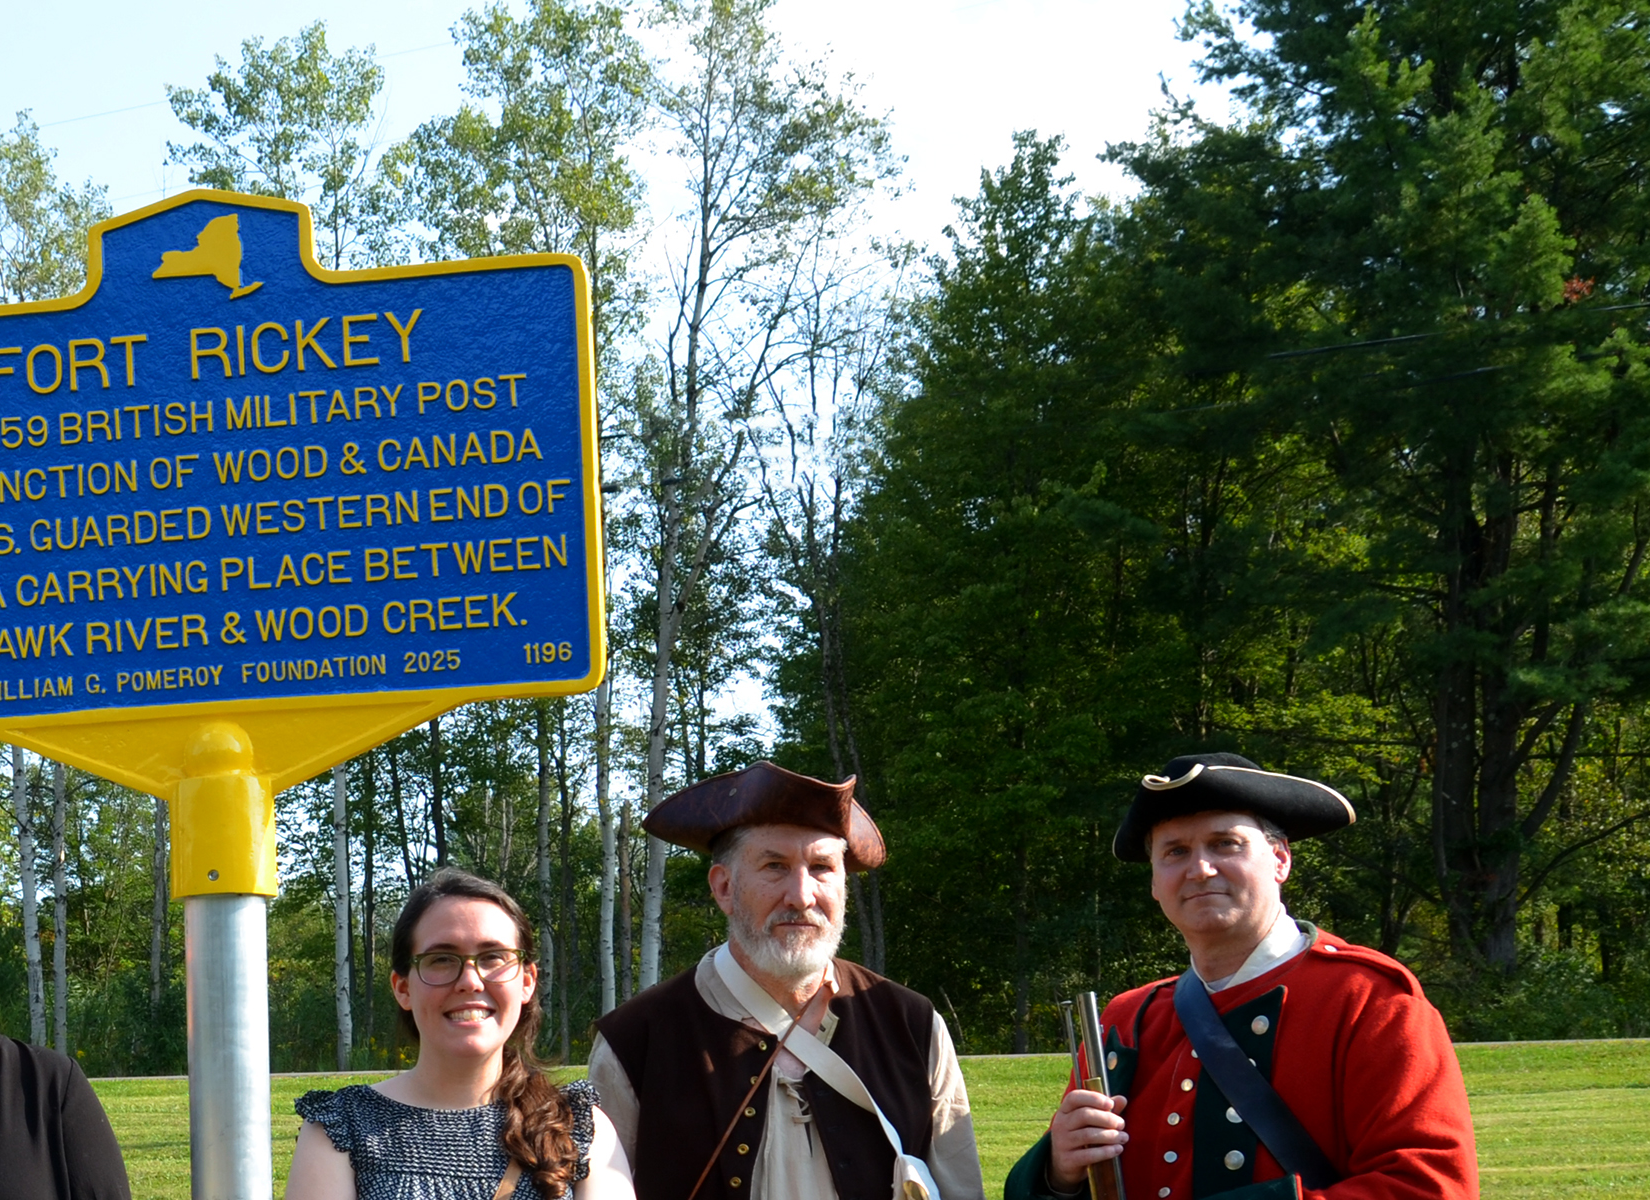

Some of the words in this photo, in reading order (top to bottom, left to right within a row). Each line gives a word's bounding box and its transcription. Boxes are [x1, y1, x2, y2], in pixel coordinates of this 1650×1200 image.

[190, 308, 423, 380] RICKEY
[59, 401, 214, 445] BRITISH
[225, 384, 403, 430] MILITARY
[417, 373, 526, 414] POST
[149, 454, 199, 490] OF
[212, 445, 328, 484] WOOD
[340, 442, 367, 475] &
[377, 428, 543, 472] CANADA
[30, 506, 211, 552] GUARDED
[220, 490, 420, 537] WESTERN
[429, 483, 509, 522] END
[518, 479, 571, 515] OF
[16, 560, 208, 607] CARRYING
[220, 550, 352, 592] PLACE
[364, 534, 568, 582] BETWEEN
[86, 614, 208, 655] RIVER
[220, 611, 247, 645] &
[254, 604, 369, 642] WOOD
[382, 592, 528, 634] CREEK.
[523, 642, 572, 664] 1196
[85, 674, 106, 694] G.
[117, 665, 223, 693] POMEROY
[241, 654, 386, 683] FOUNDATION
[404, 649, 461, 673] 2025
